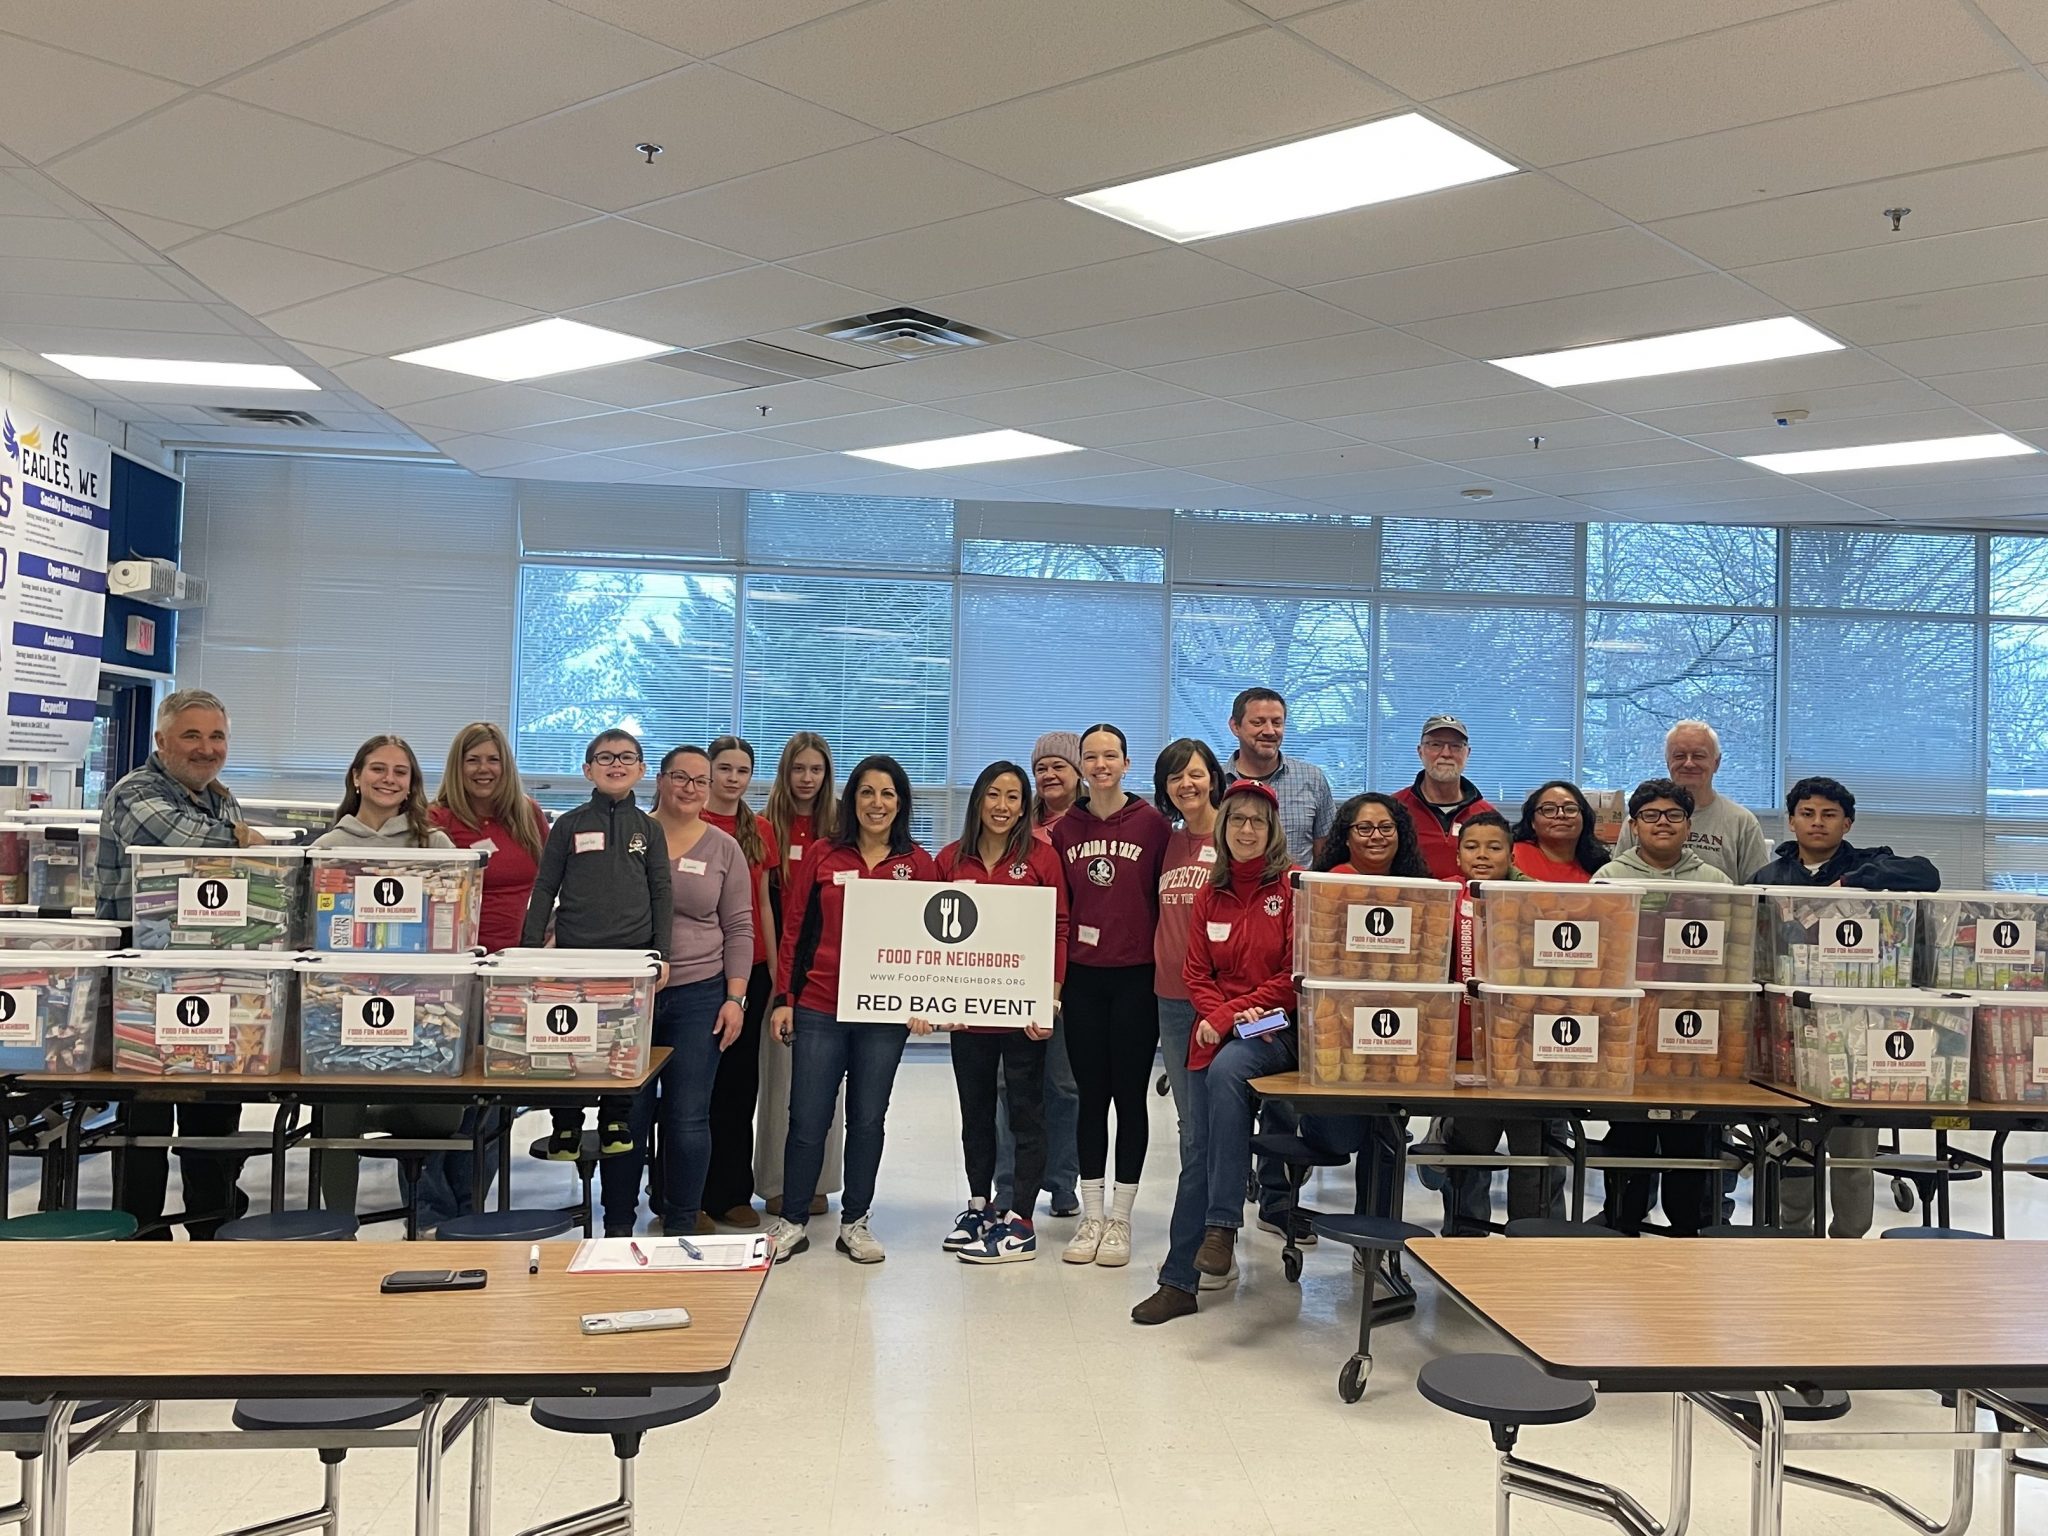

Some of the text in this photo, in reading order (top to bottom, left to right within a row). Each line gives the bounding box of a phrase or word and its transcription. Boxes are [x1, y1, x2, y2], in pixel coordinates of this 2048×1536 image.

[52, 430, 69, 459] AS
[22, 448, 98, 498] EAGLES, WE
[1181, 893, 1197, 905] YOR
[1461, 919, 1473, 966] NEIGHBORS
[877, 948, 912, 965] FOOD
[916, 950, 941, 966] FOR
[857, 994, 1037, 1016] RED BAG EVENT
